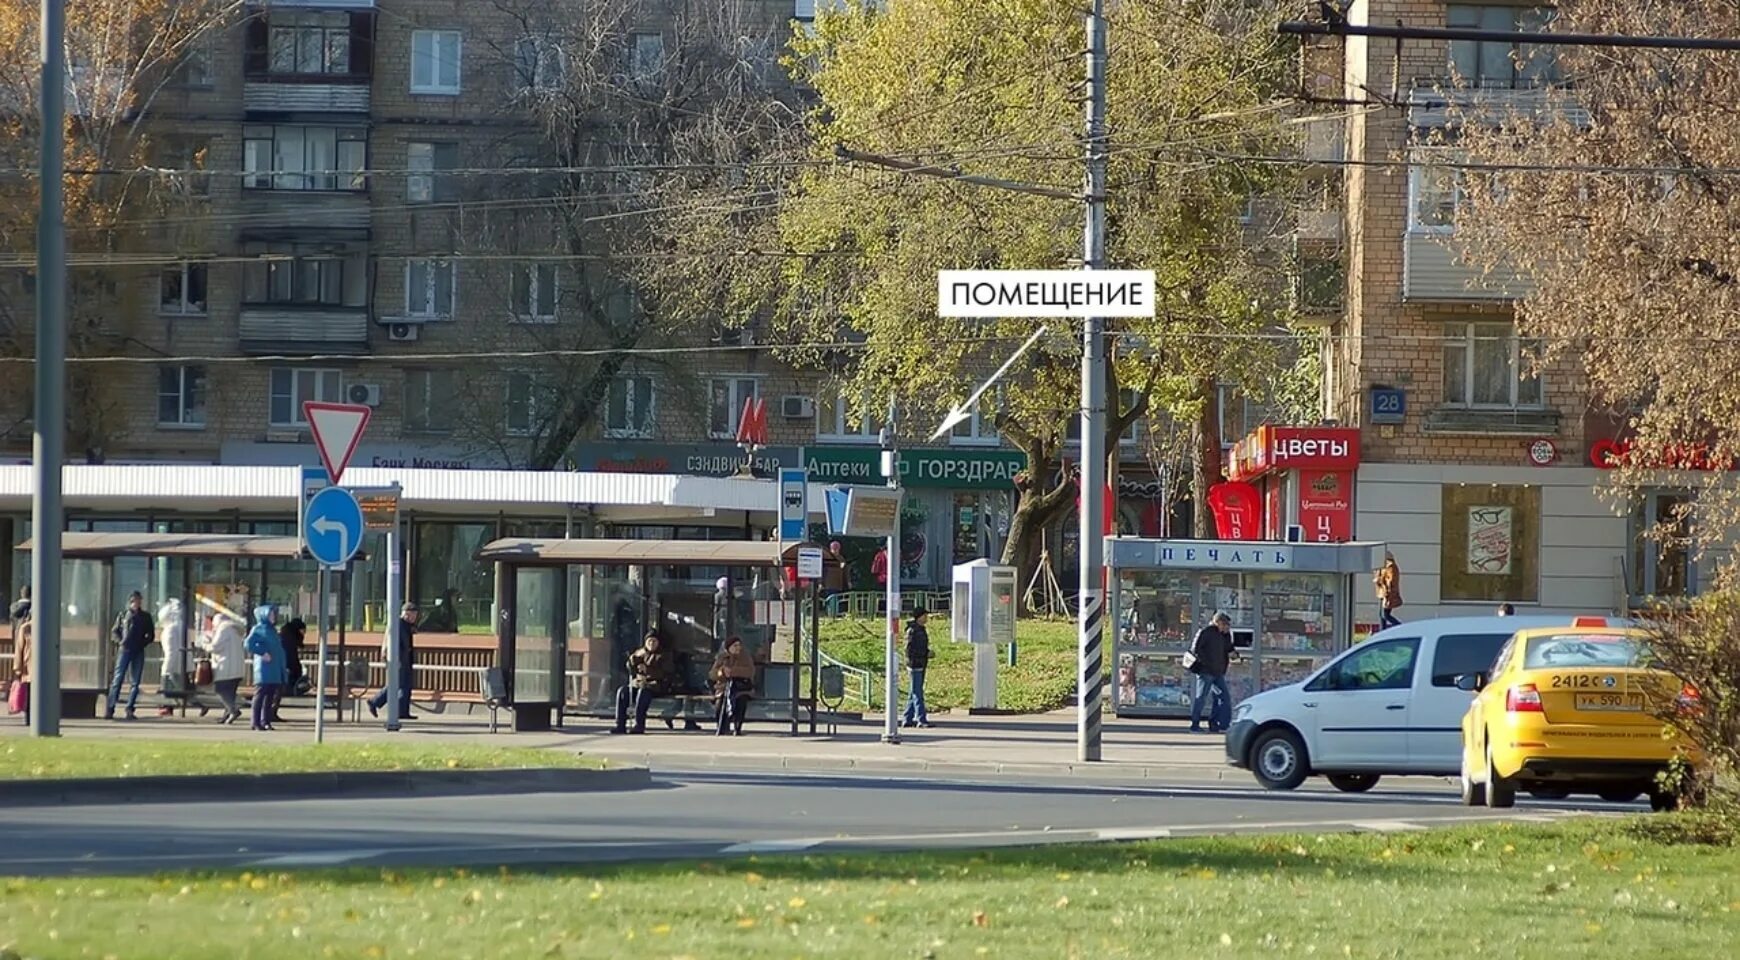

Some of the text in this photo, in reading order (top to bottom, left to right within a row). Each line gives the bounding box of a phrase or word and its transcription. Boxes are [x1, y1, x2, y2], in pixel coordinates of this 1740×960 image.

[1378, 394, 1400, 411] 28
[807, 457, 1020, 482] Аптеки ГОРЗДРАВ
[1162, 547, 1286, 564] ПЕЧАТЬ
[1600, 694, 1623, 706] 590
